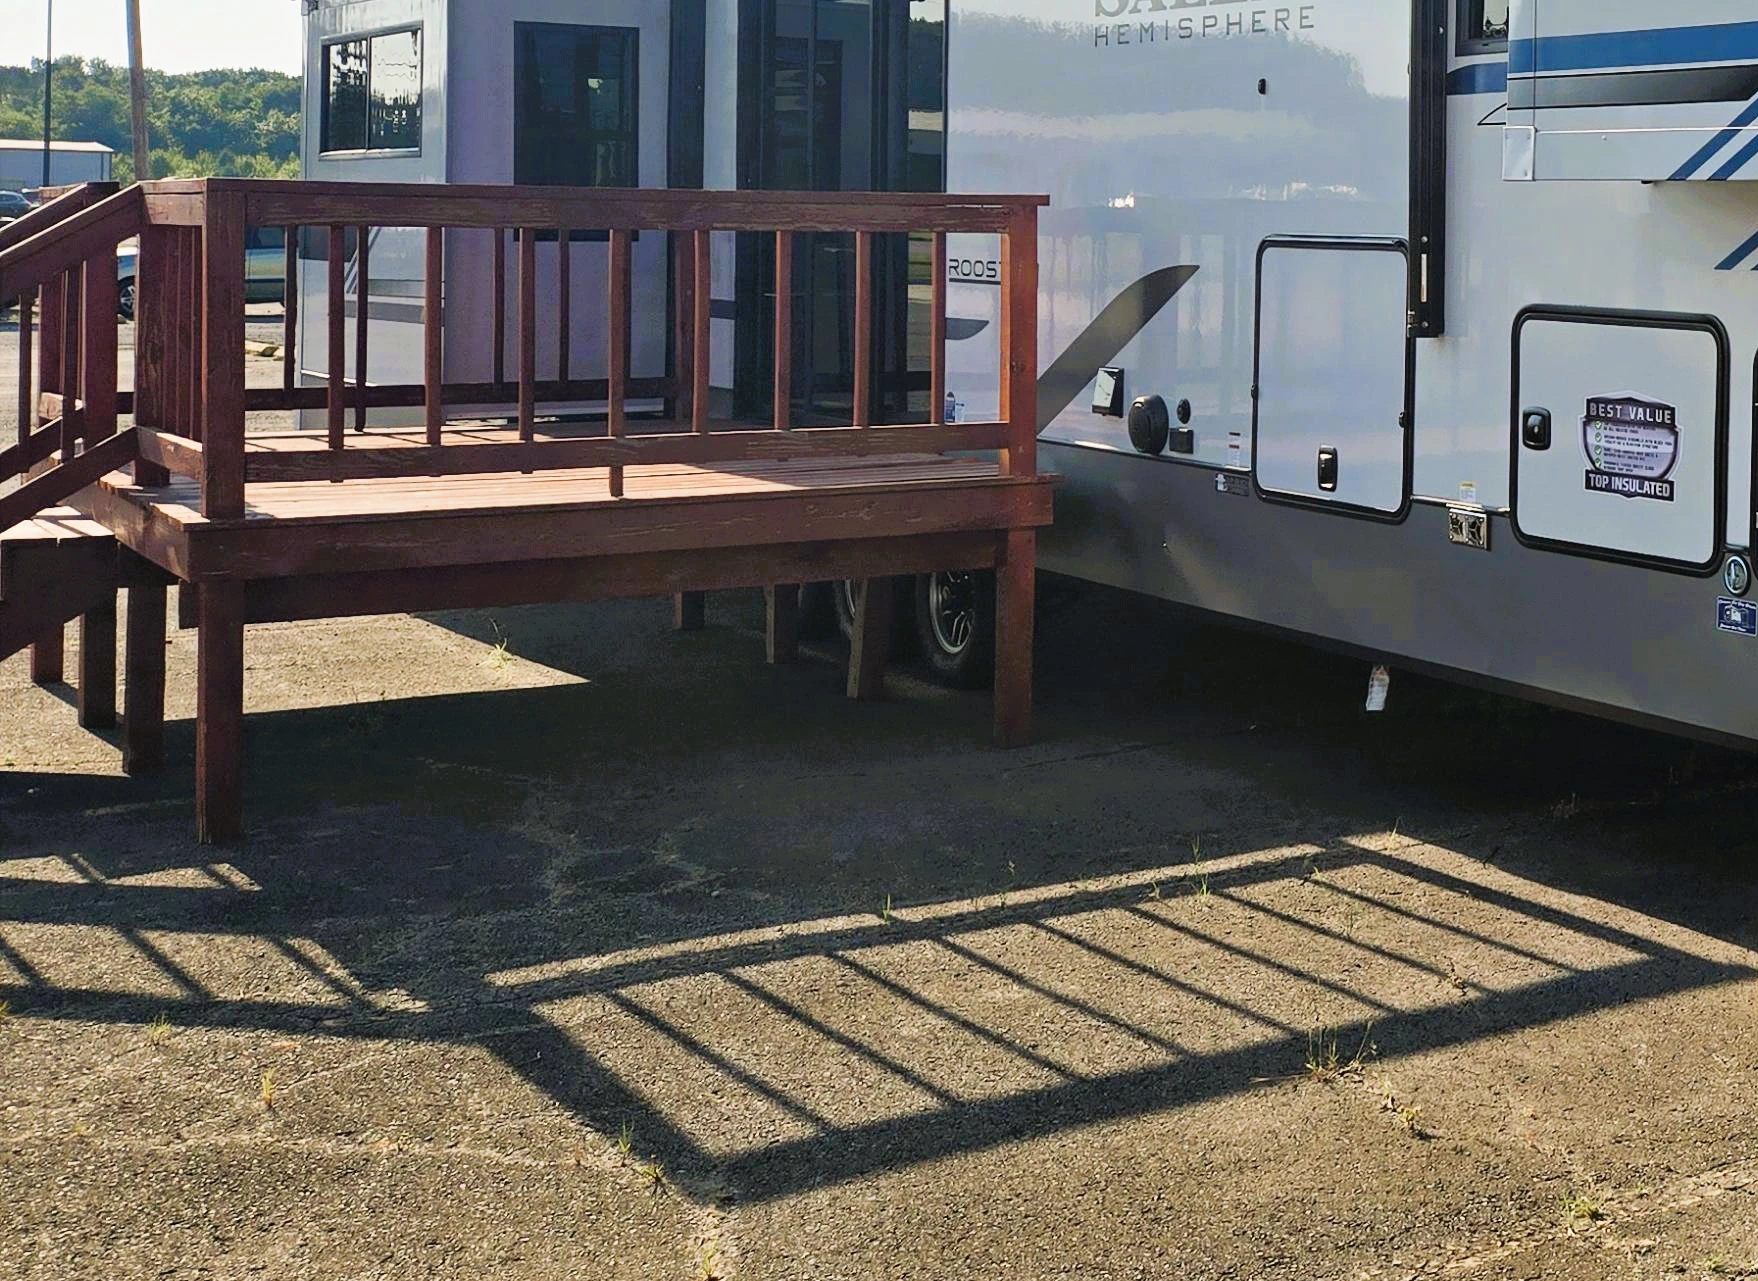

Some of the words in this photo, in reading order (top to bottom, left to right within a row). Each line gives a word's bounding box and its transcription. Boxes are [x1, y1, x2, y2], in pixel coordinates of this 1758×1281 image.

[1094, 5, 1315, 48] HEMISPHERE
[948, 258, 1002, 279] ROOS
[1589, 402, 1623, 419] BEST
[1628, 406, 1673, 424] VALUE
[1588, 473, 1609, 489] TOP
[1611, 476, 1671, 498] INSULATED
